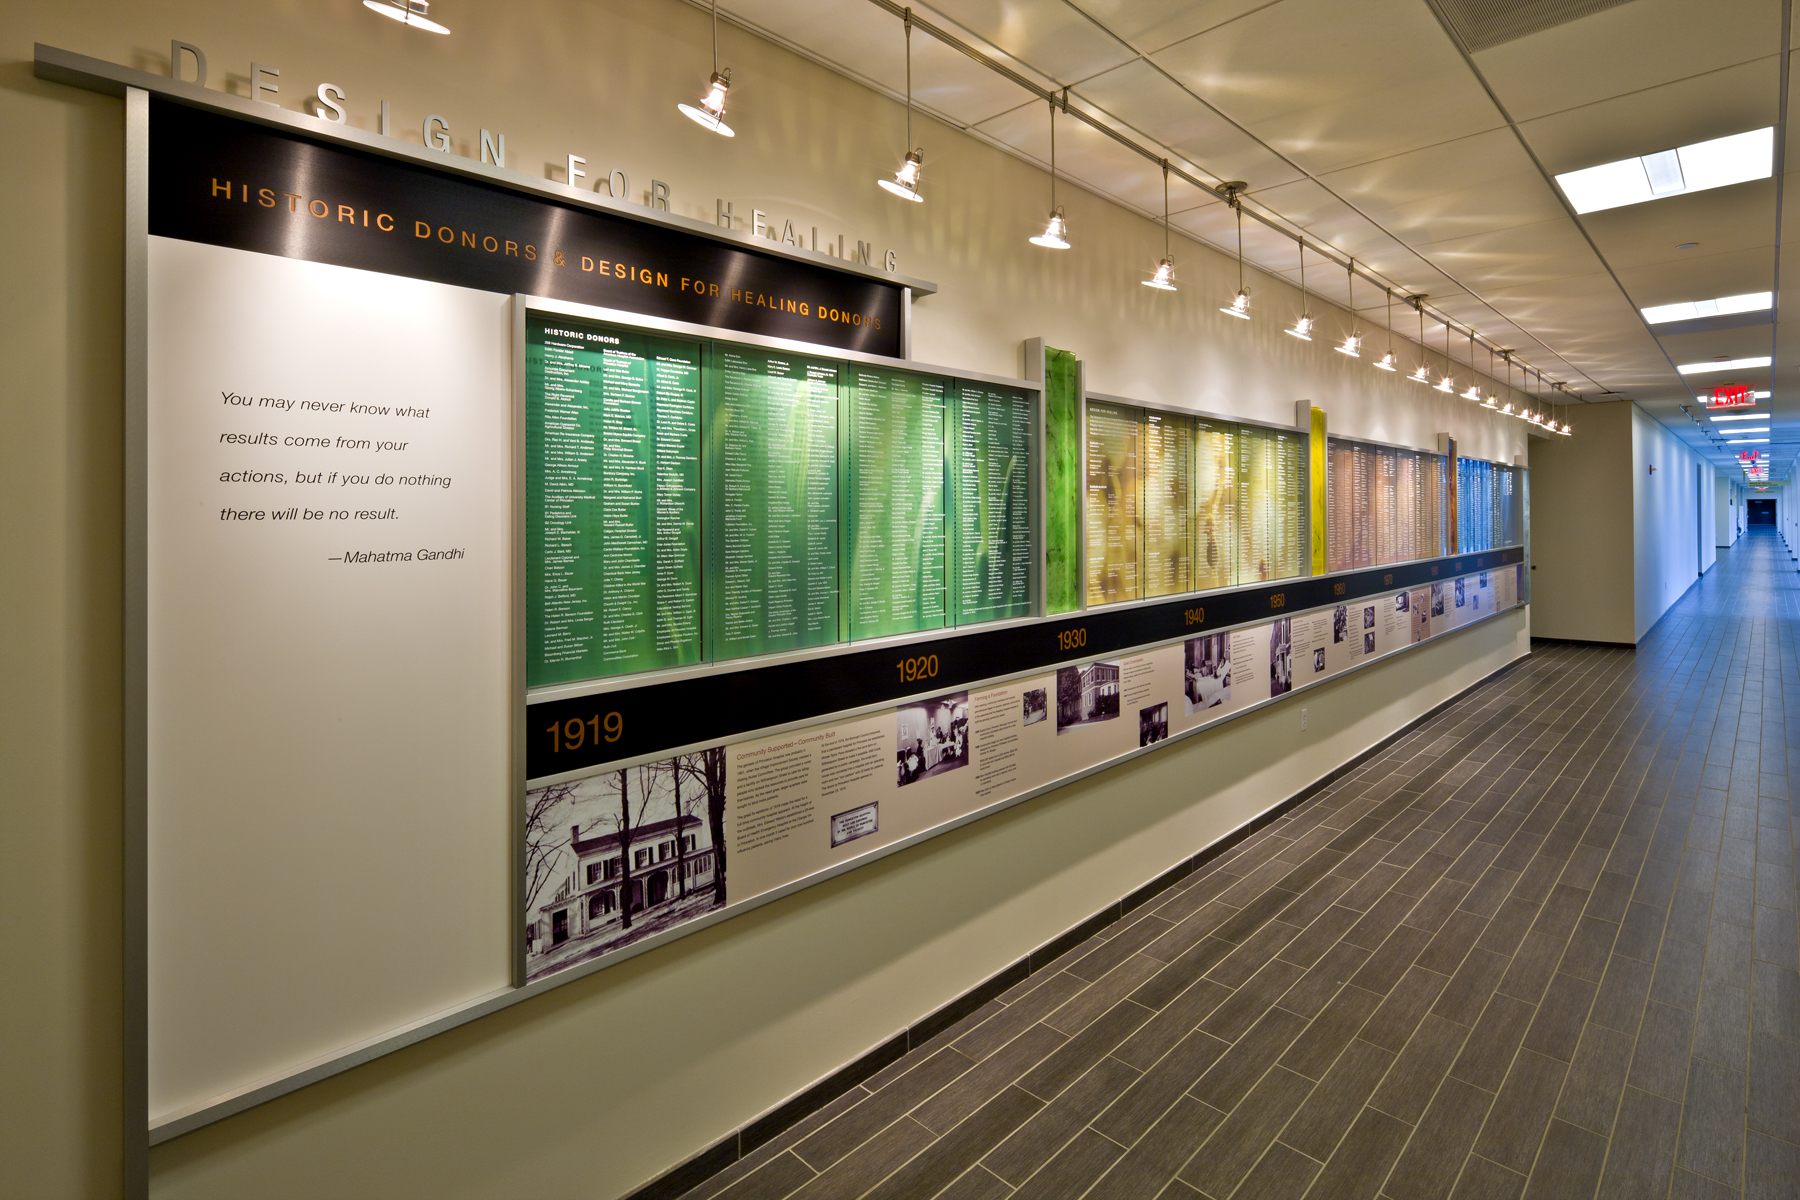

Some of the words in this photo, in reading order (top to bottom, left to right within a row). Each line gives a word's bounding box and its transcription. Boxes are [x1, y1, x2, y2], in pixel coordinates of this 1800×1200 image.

[171, 39, 505, 169] DESIGN
[567, 154, 671, 214] FOR
[716, 198, 897, 274] HEALING
[212, 177, 395, 233] HISTORIC
[415, 220, 537, 261] DONORS
[553, 250, 566, 267] &
[581, 256, 669, 288] DESIGN
[681, 277, 720, 299] FOR
[731, 287, 810, 316] HEALING
[818, 306, 882, 330] DONORS
[544, 327, 584, 339] HISTORIC
[586, 334, 620, 345] DONORS
[221, 391, 253, 406] You
[258, 397, 295, 412] may
[300, 401, 346, 413] never
[350, 401, 391, 416] know
[395, 406, 430, 419] what
[1714, 386, 1747, 406] EXIT
[219, 432, 278, 446] results
[284, 436, 331, 448] come
[336, 436, 370, 449] from
[375, 440, 409, 452] your
[219, 469, 289, 485] actions,
[295, 471, 323, 484] but
[327, 471, 338, 484] if
[341, 474, 370, 487] you
[374, 473, 394, 485] do
[398, 474, 452, 489] nothing
[220, 507, 266, 521] there
[271, 507, 298, 521] will
[302, 508, 324, 520] be
[329, 509, 349, 520] no
[354, 508, 399, 520] result.
[416, 548, 465, 561] Gandhi
[1333, 582, 1346, 596] 1960
[1270, 593, 1285, 609] 1950
[1184, 607, 1204, 626] 1940
[1057, 628, 1087, 650] 1930
[896, 654, 939, 683] 1920
[546, 711, 623, 753] 1919
[736, 748, 766, 760] Community
[825, 731, 836, 739] Built
